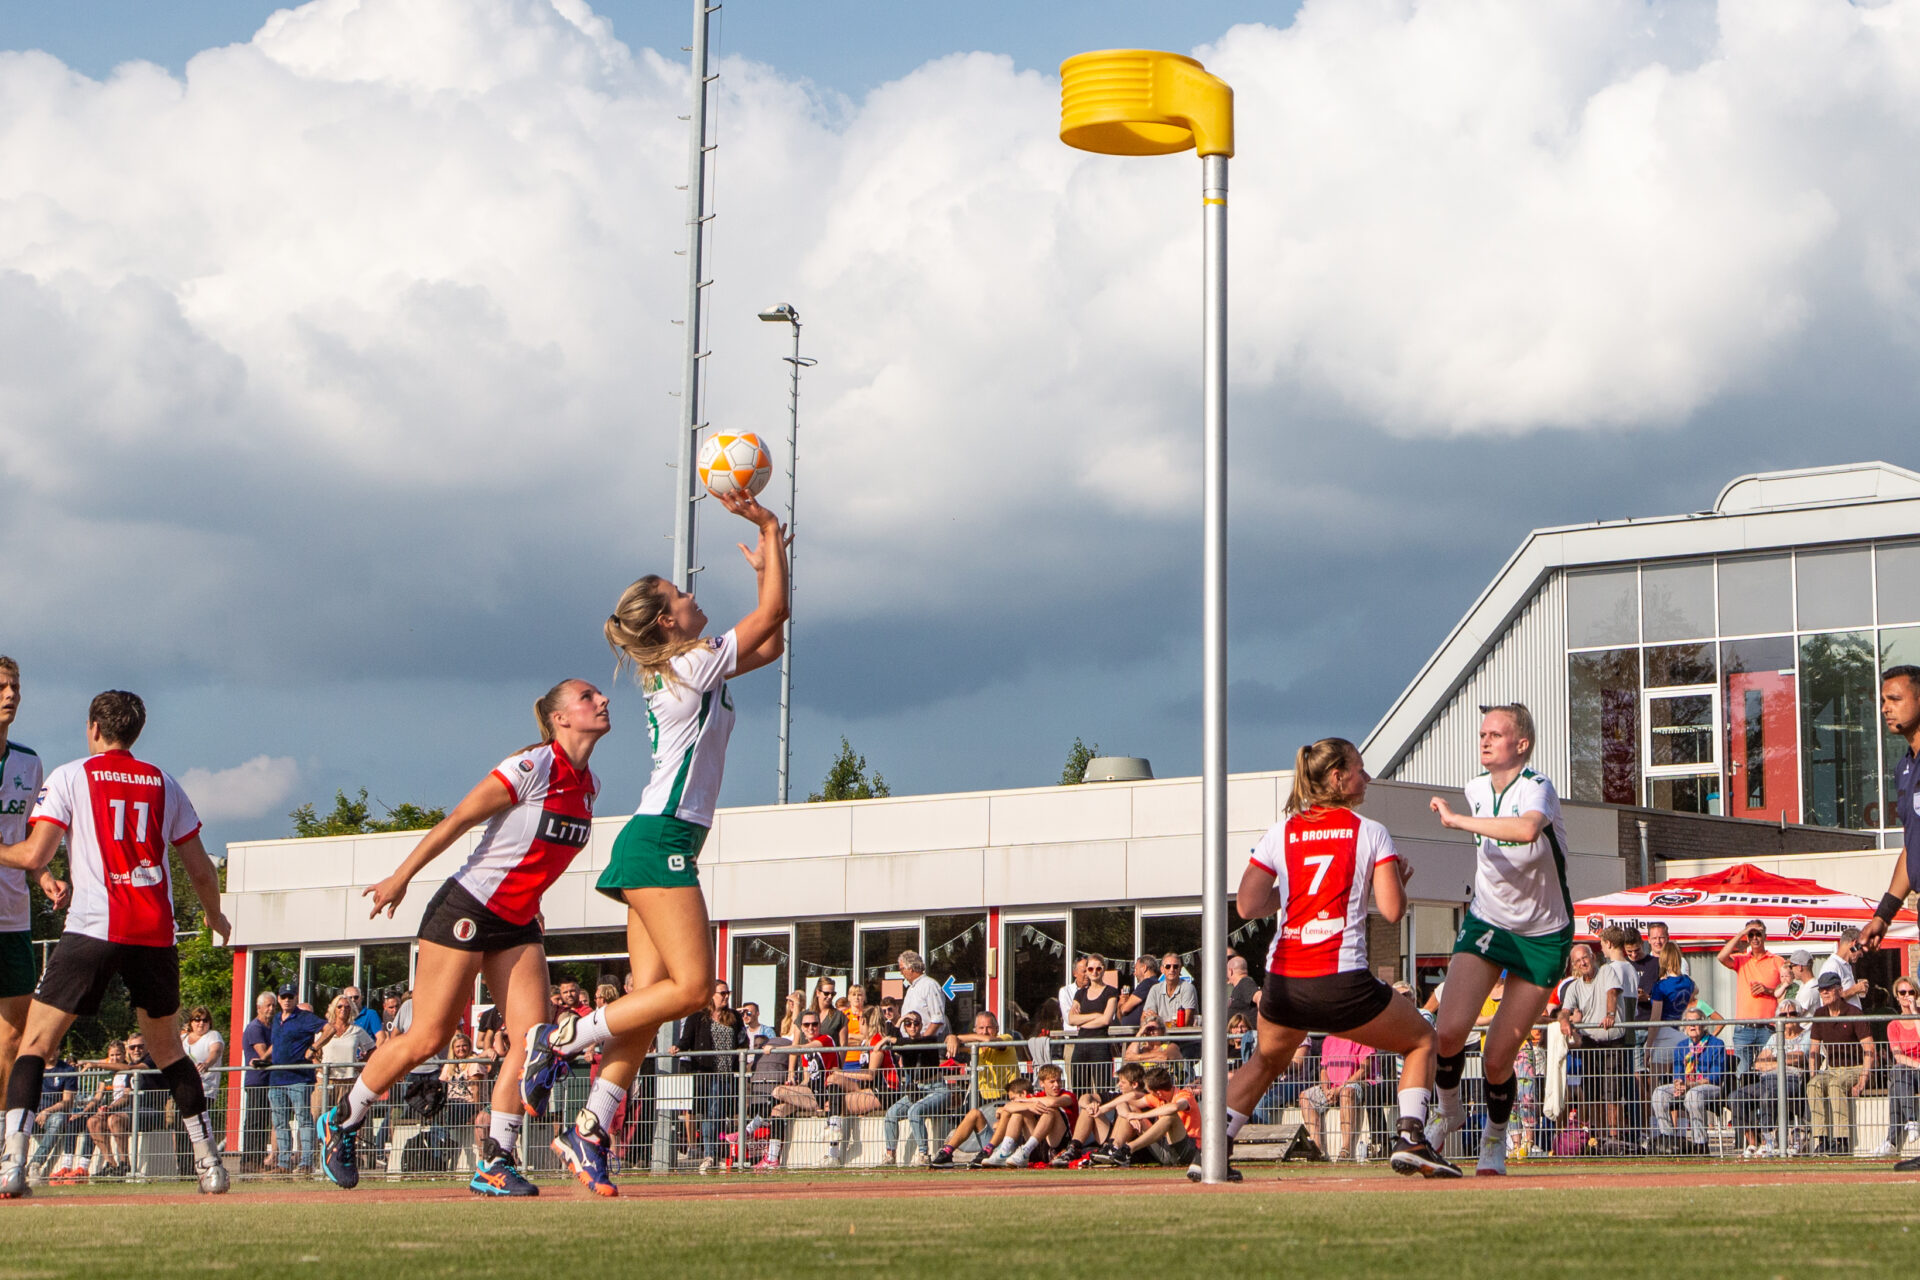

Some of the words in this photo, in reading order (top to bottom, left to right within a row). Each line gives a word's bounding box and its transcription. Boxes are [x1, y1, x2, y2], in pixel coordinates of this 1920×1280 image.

[91, 770, 162, 787] TIGGELMAN
[109, 798, 149, 843] 11
[1289, 833, 1299, 844] B.
[1302, 828, 1353, 842] BROUWER
[1303, 854, 1335, 896] 7
[1712, 895, 1829, 905] Jupiler
[1305, 926, 1333, 936] Lemkes
[1608, 919, 1650, 930] Jupile
[1808, 920, 1856, 935] Jupile
[1475, 929, 1495, 954] 4
